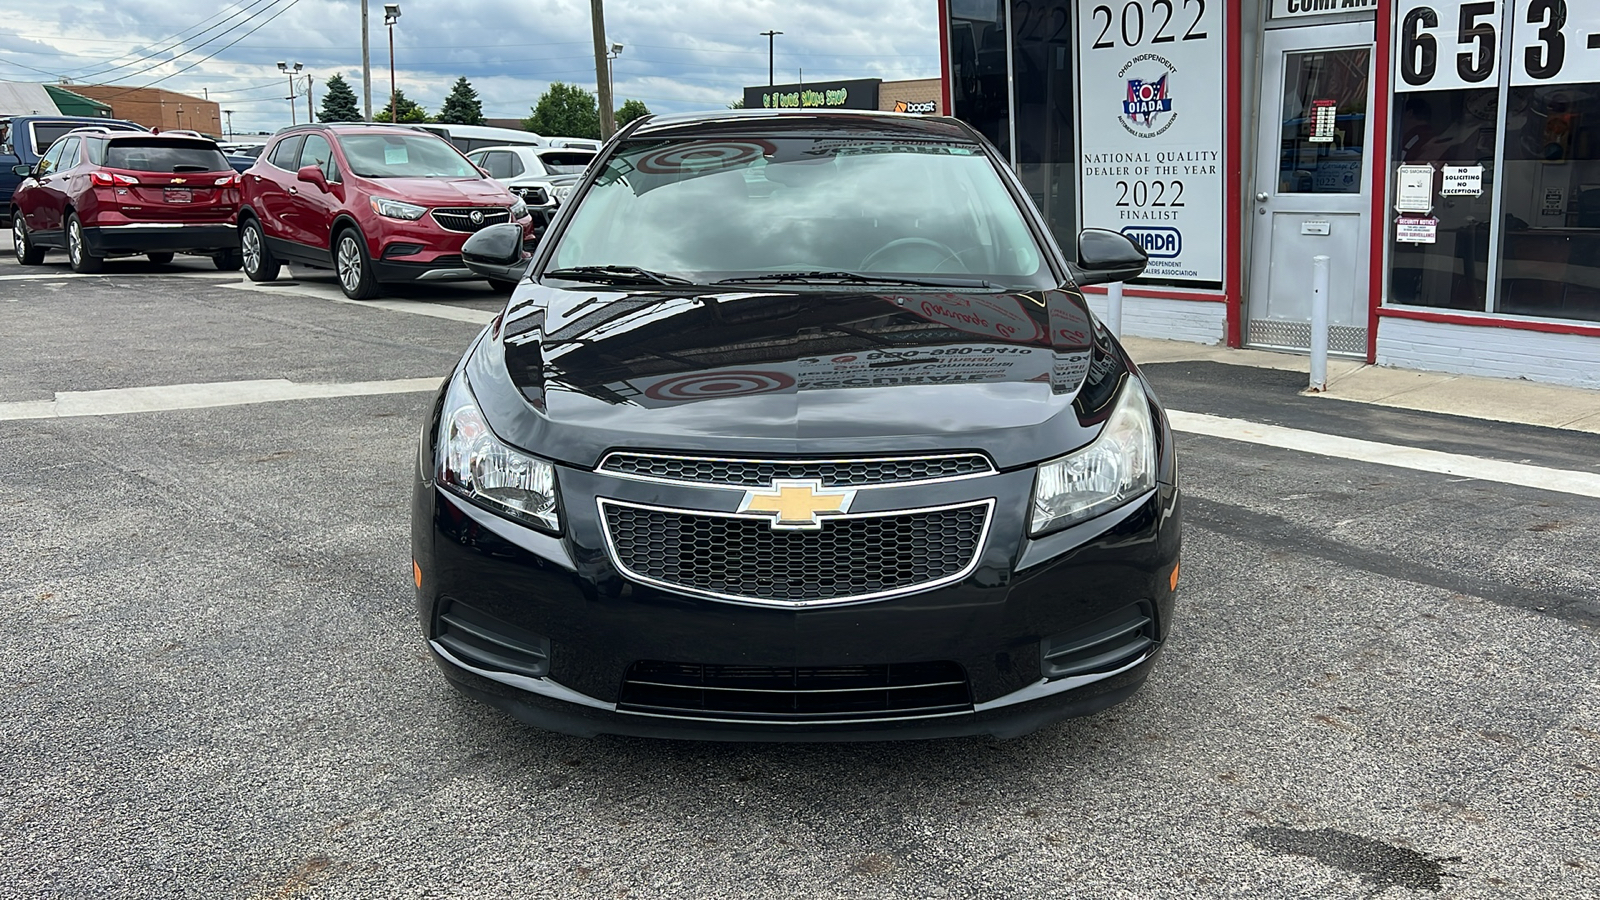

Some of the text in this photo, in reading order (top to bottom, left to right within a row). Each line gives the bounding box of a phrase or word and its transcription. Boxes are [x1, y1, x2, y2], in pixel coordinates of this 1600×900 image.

[1287, 0, 1377, 13] COMA
[1092, 0, 1207, 49] 2022
[1118, 54, 1177, 78] OHIO INDEPENDENT
[825, 87, 847, 106] SHOP
[907, 101, 935, 112] boost
[1129, 100, 1164, 112] OIADA
[1117, 112, 1178, 139] AUTOMOBILE DEALERS ASSOCIATION
[1084, 151, 1218, 164] NATIONAL QUALITY
[1086, 165, 1216, 176] DEALER OF THE YEAR
[1115, 180, 1185, 207] 2022
[1120, 210, 1178, 220] FINALIST
